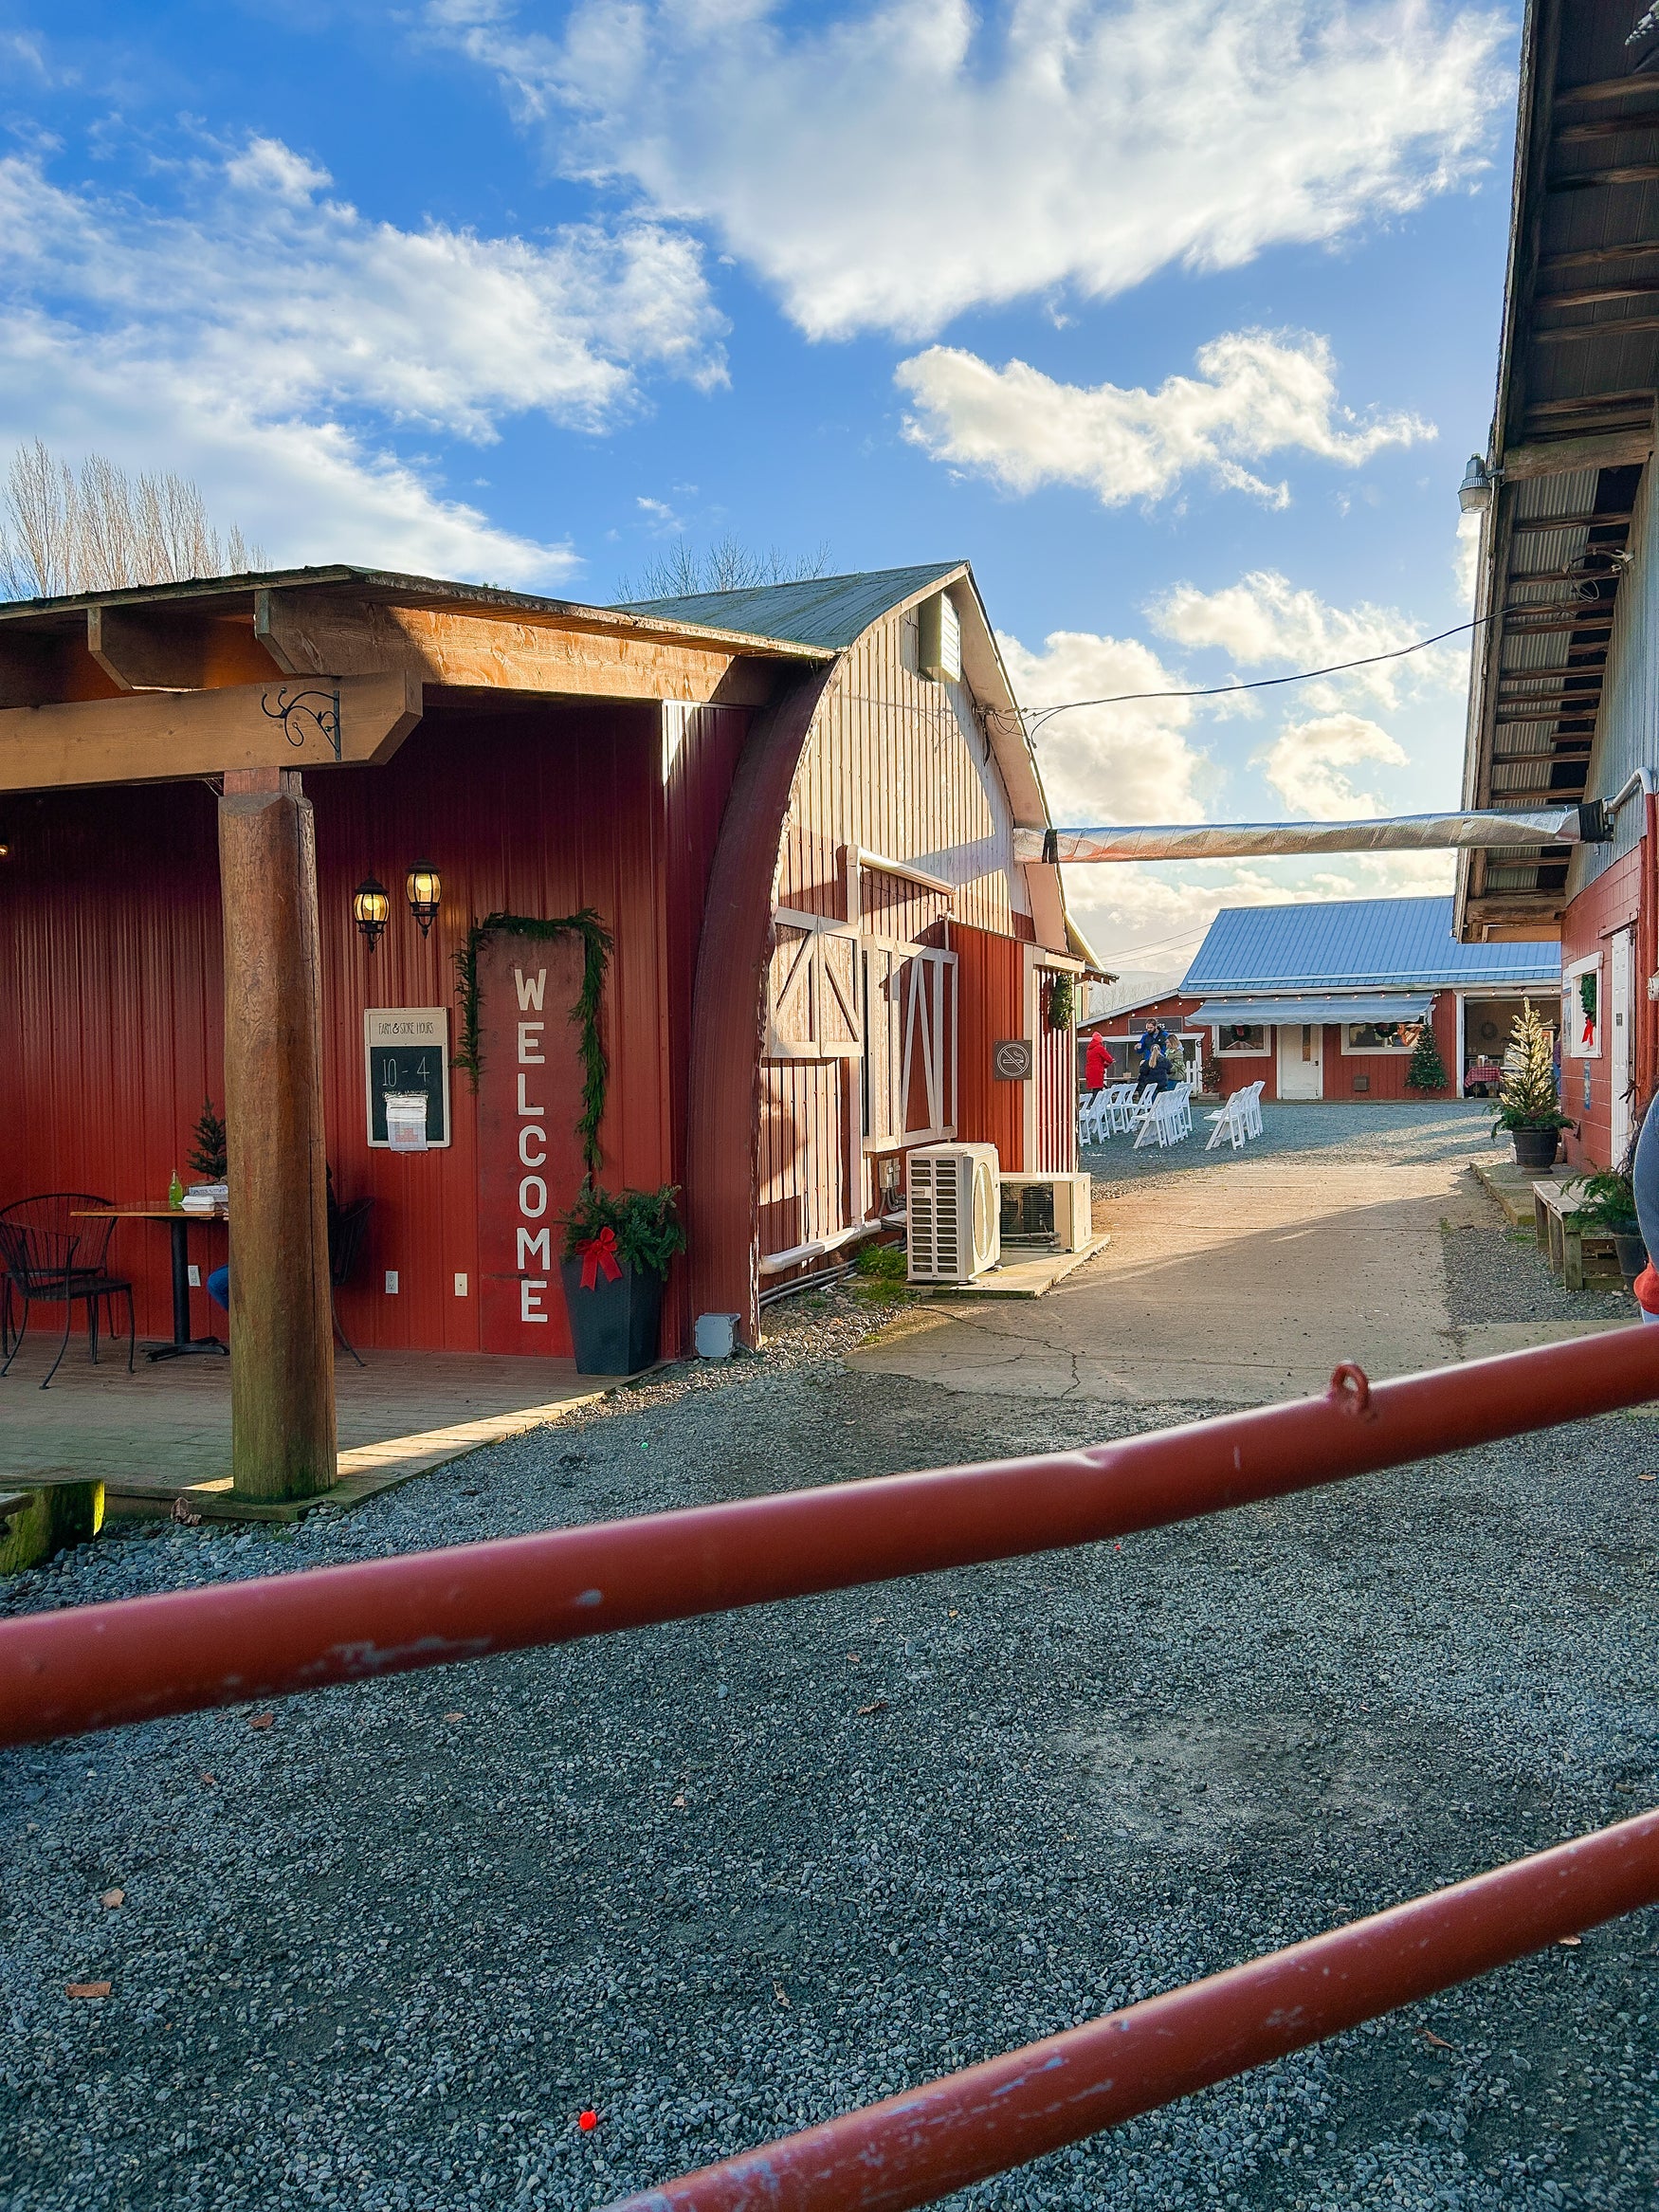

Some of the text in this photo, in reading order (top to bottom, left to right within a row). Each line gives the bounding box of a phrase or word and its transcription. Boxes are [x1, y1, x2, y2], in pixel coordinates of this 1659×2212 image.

[378, 1022, 392, 1034] FARM
[400, 1022, 414, 1034] STORE
[416, 1021, 433, 1034] HOURS
[382, 1058, 397, 1087] 10
[417, 1056, 429, 1083] 4
[514, 968, 550, 1323] WELCOME
